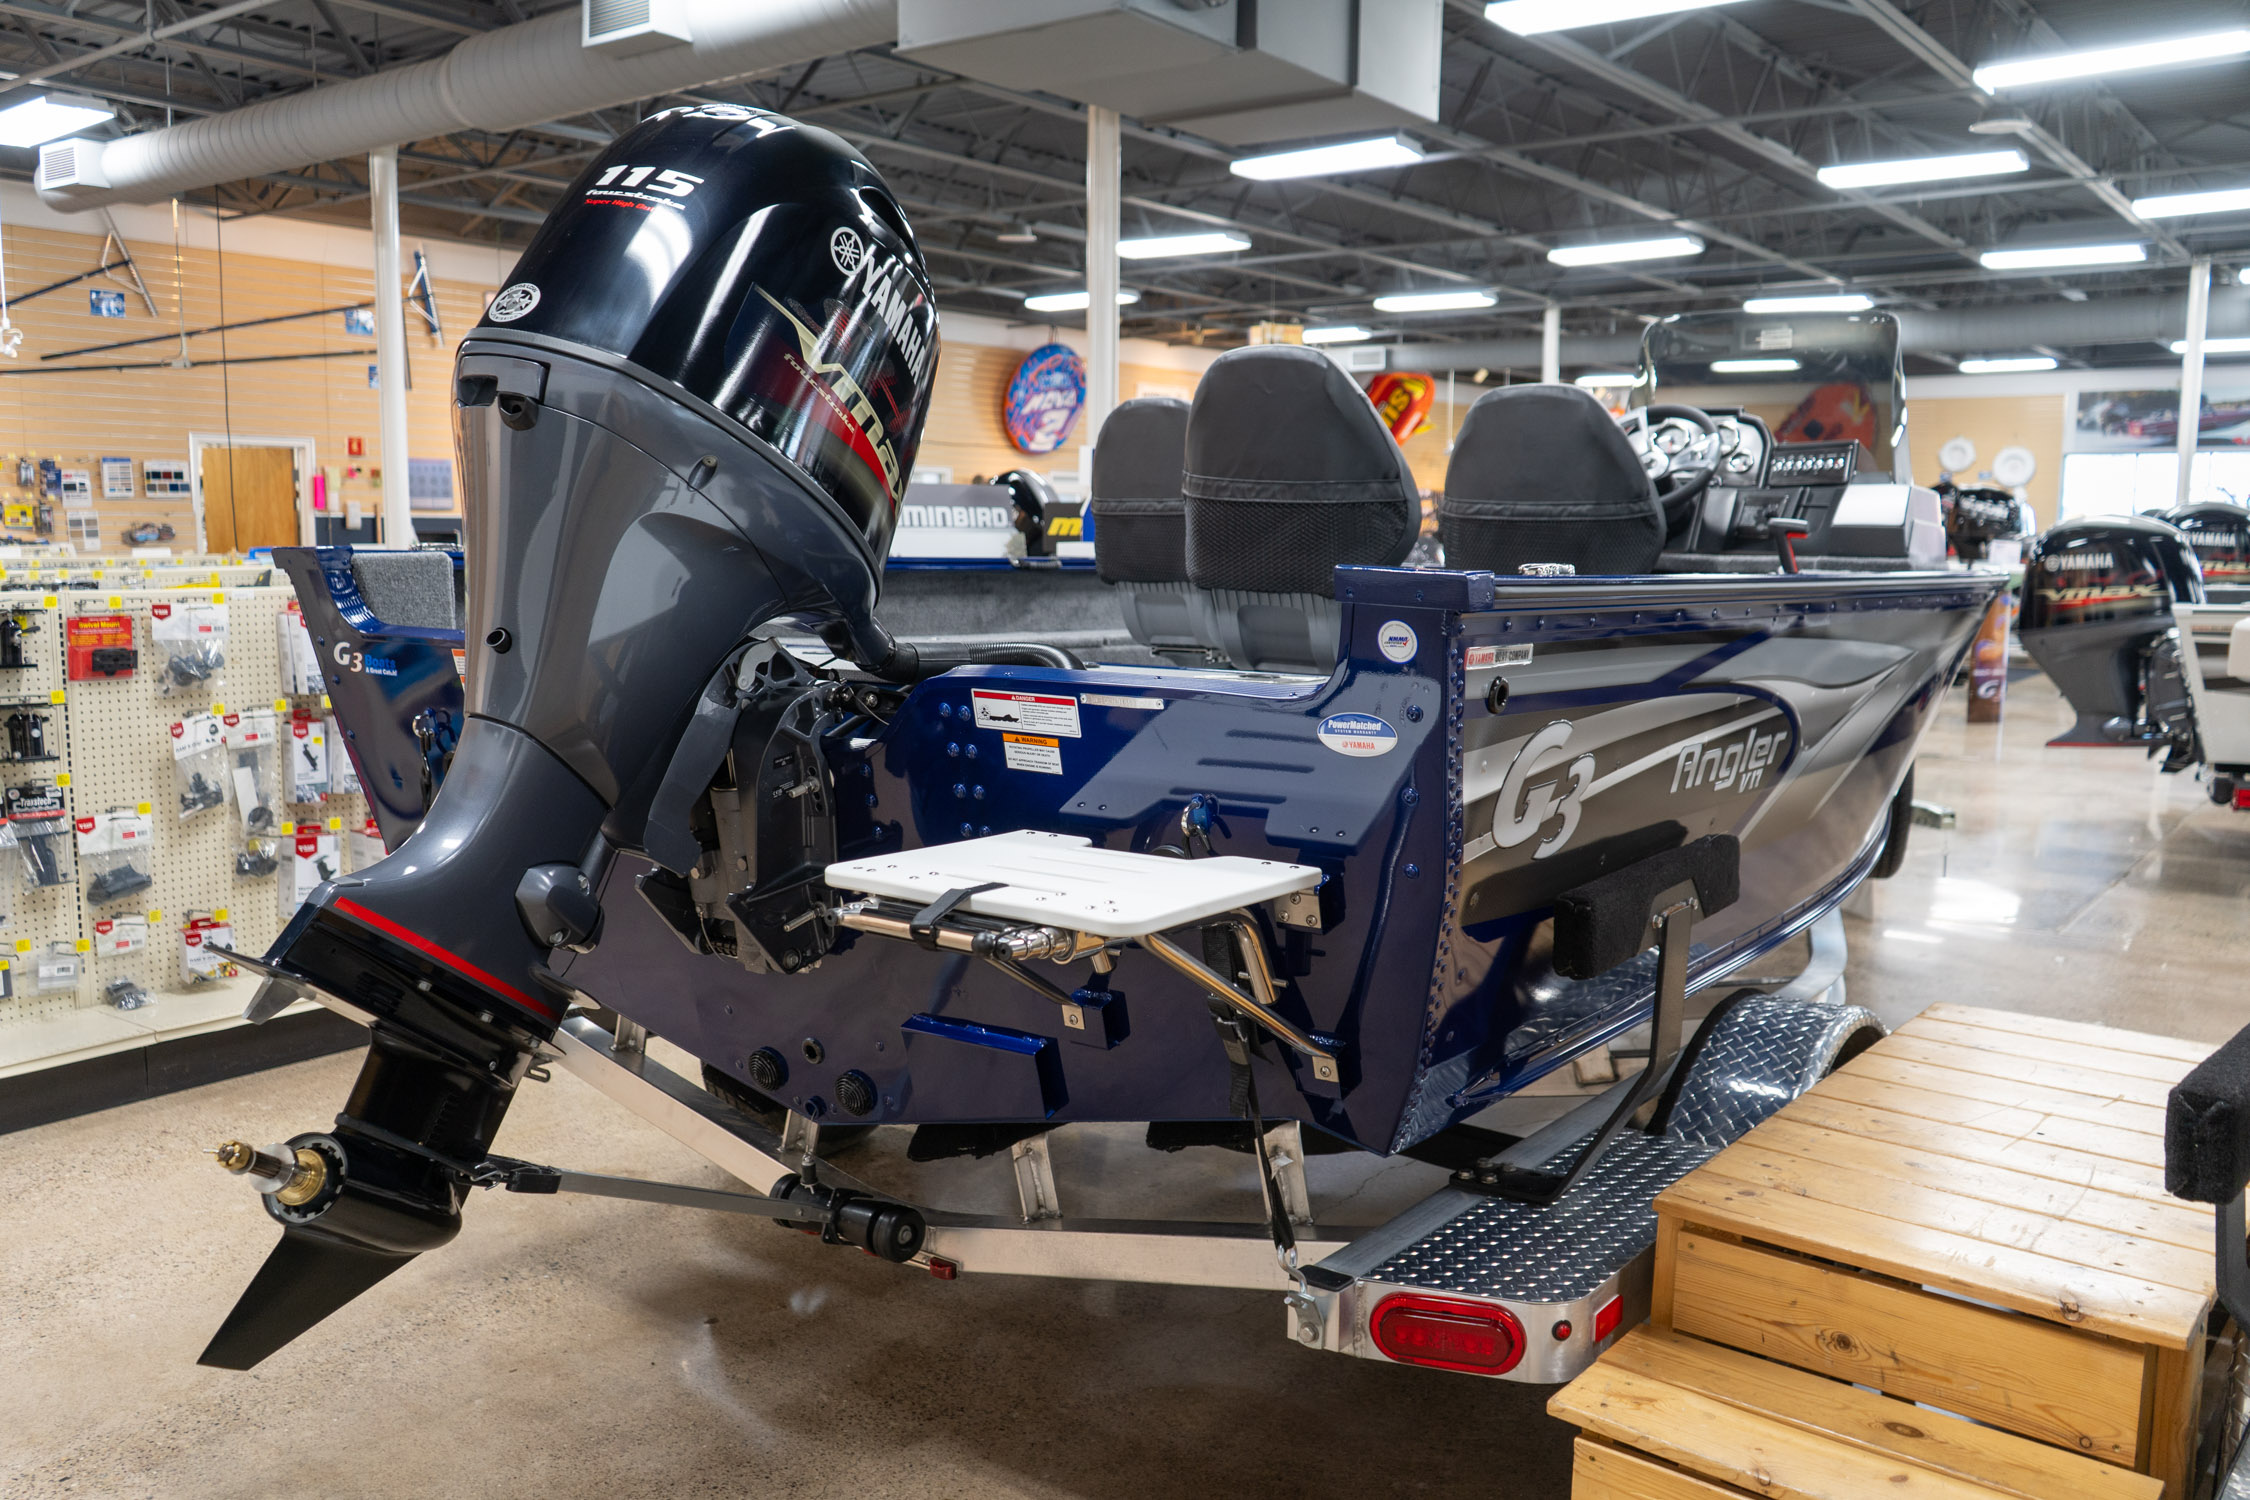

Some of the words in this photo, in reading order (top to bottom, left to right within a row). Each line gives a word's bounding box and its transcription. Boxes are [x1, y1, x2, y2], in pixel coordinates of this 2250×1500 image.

[595, 164, 705, 197] 115
[584, 198, 612, 206] Super
[611, 199, 635, 208] High
[861, 254, 927, 386] YAMAHA
[784, 353, 855, 433] fourstroke
[900, 505, 1009, 528] MINBIRD
[2191, 531, 2236, 547] YAMAHA
[2060, 552, 2114, 570] YAMAHA
[78, 621, 100, 629] Swivel
[100, 620, 121, 629] Mount
[364, 654, 397, 669] Boats
[1475, 652, 1495, 664] YAMAHA
[1508, 649, 1530, 661] COMPANY
[1328, 719, 1382, 731] PowerMatched
[1021, 737, 1048, 745] WARNING
[1349, 741, 1376, 750] YAMAHA
[1670, 727, 1788, 794] Angler
[1491, 718, 1597, 861] G3
